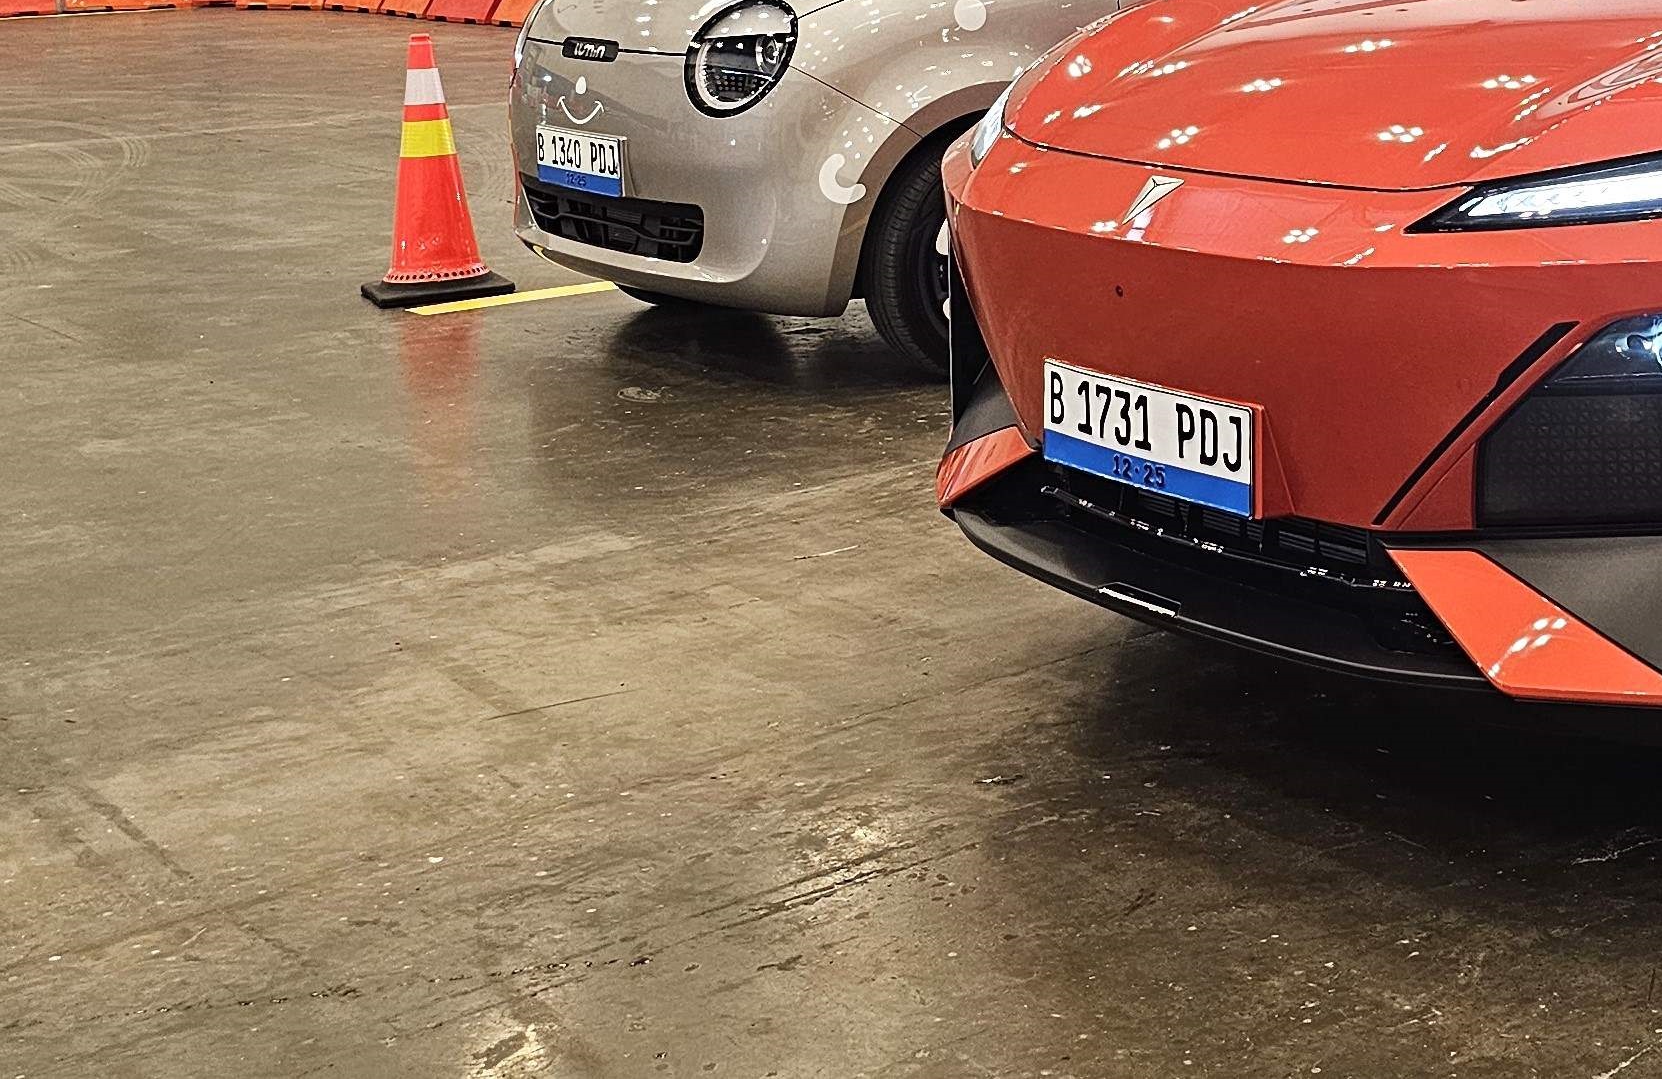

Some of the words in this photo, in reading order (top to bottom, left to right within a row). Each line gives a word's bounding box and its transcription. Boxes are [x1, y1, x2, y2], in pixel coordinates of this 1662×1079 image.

[537, 132, 545, 162] B
[551, 135, 581, 169] 1340
[590, 141, 617, 176] PDJ
[1050, 371, 1065, 425] B
[1077, 380, 1152, 452] 1731
[1175, 402, 1242, 473] PDJ
